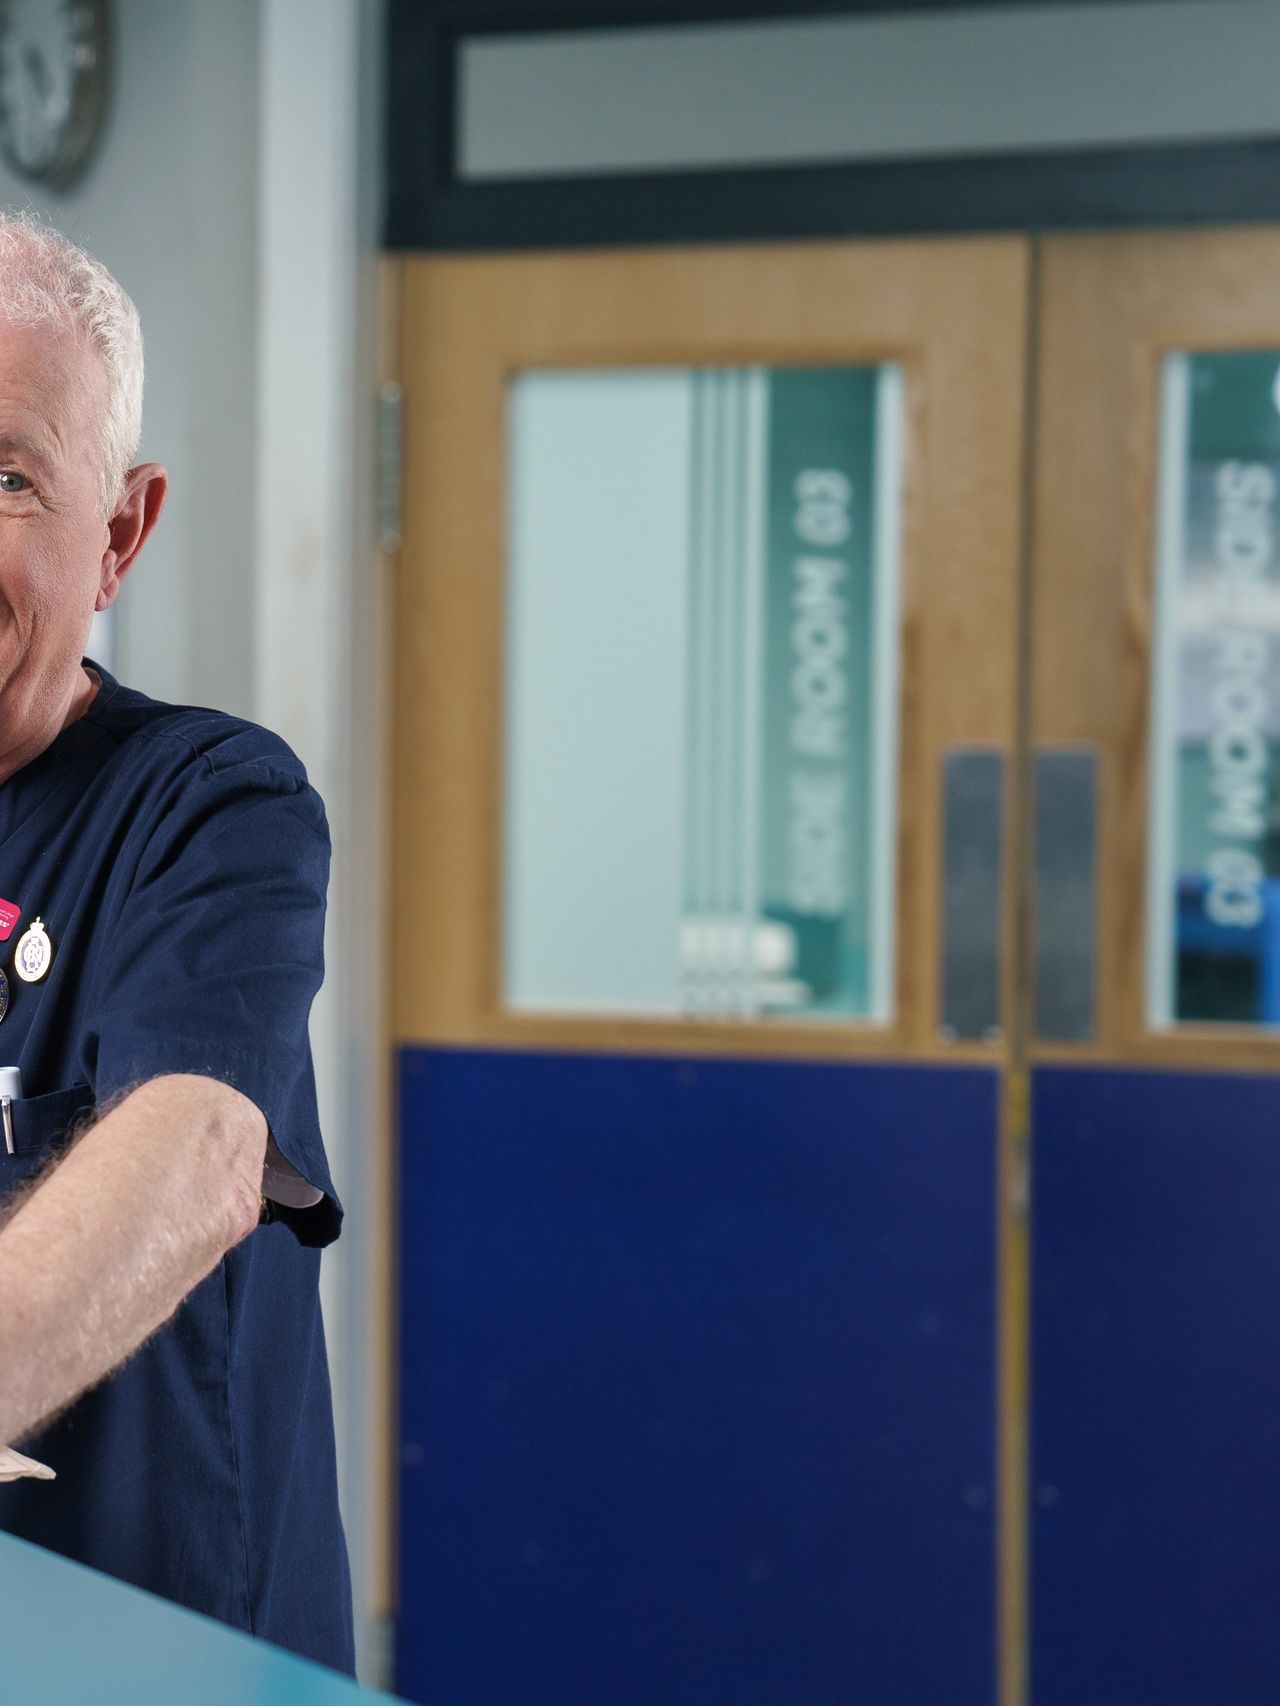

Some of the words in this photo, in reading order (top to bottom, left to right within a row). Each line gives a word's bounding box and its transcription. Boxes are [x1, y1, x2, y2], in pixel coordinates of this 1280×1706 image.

[1215, 461, 1275, 611] SIDE
[789, 556, 849, 758] ROOM
[1208, 631, 1267, 836] ROOM
[788, 772, 847, 915] SIDE
